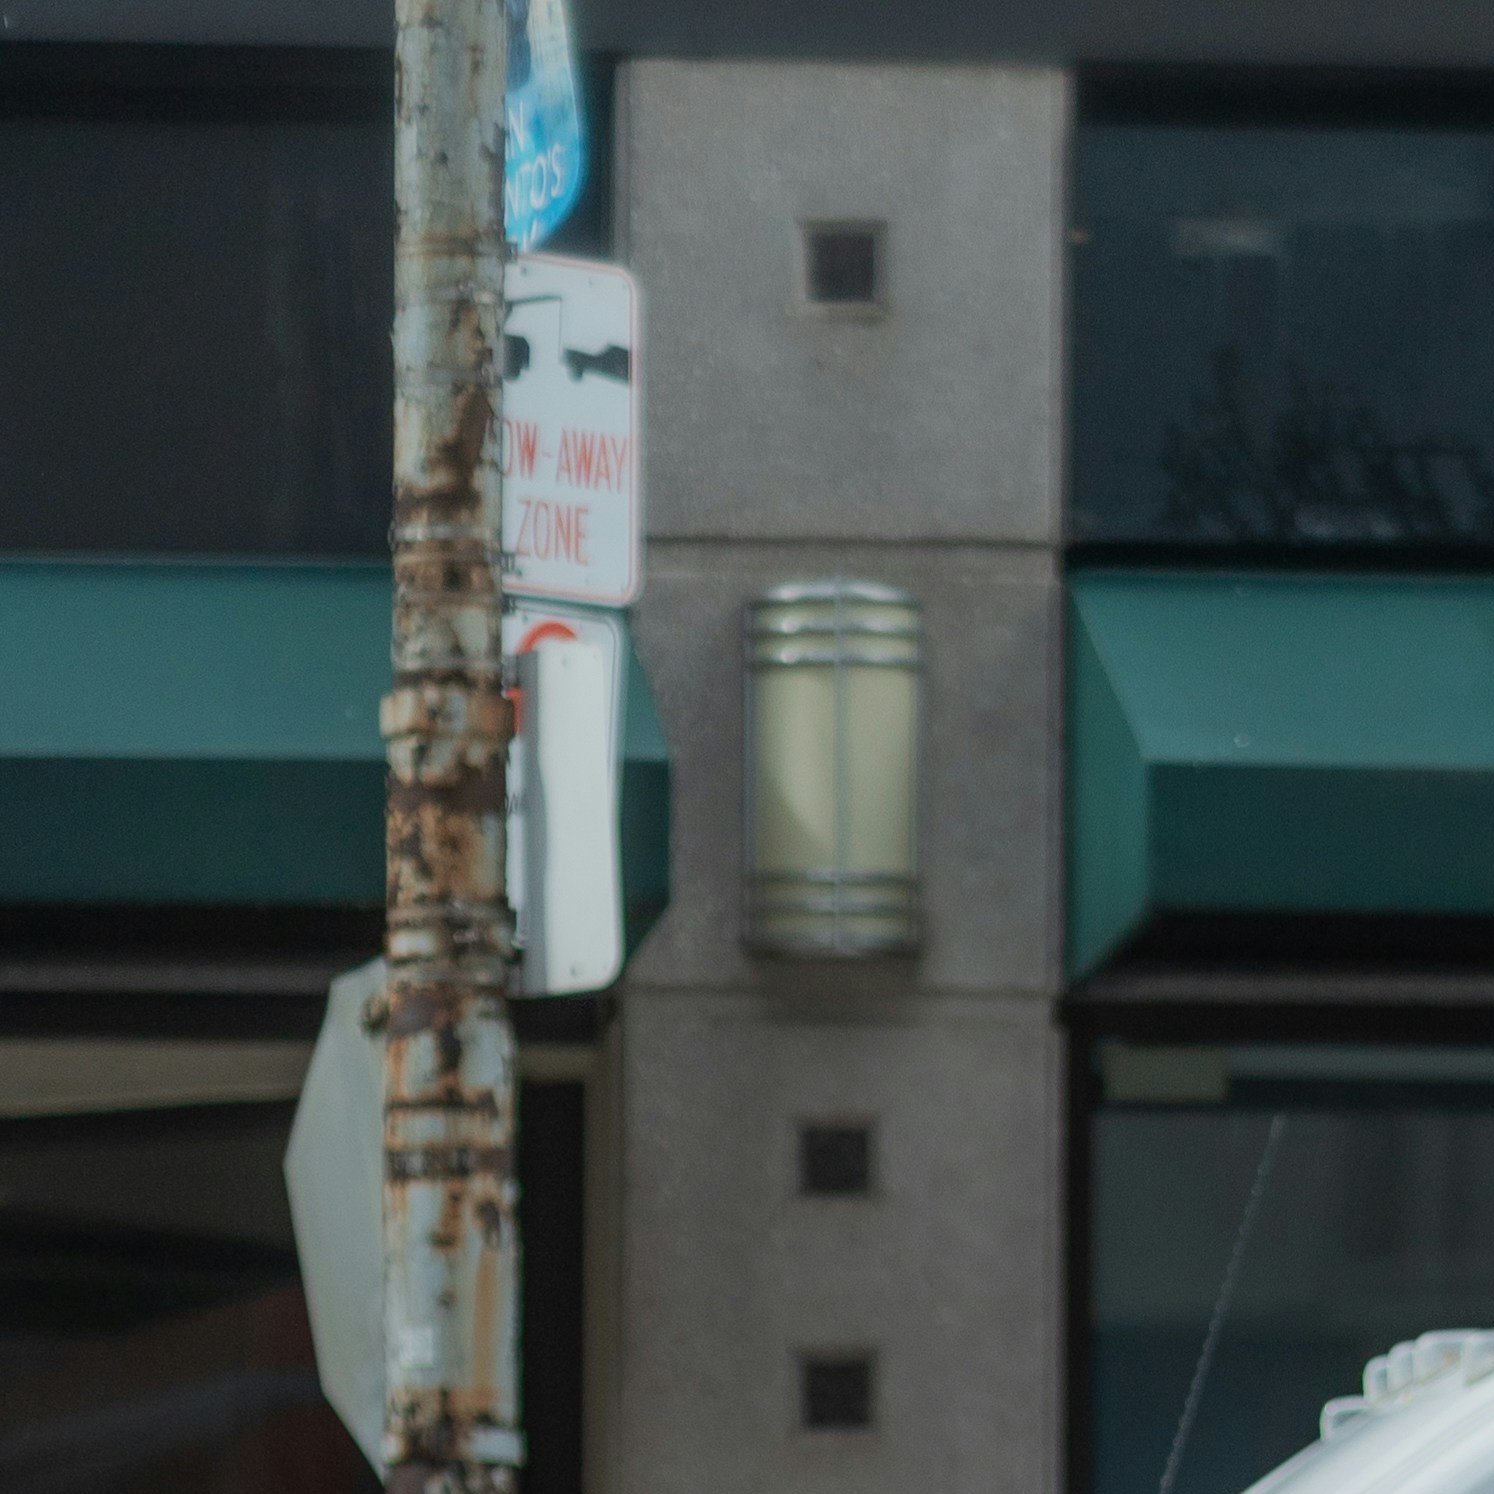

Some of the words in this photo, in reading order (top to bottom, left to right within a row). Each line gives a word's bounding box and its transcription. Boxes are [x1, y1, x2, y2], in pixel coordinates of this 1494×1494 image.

[504, 143, 567, 227] NTO'S
[502, 418, 628, 494] OW-AWAY
[516, 496, 590, 566] ZONE
